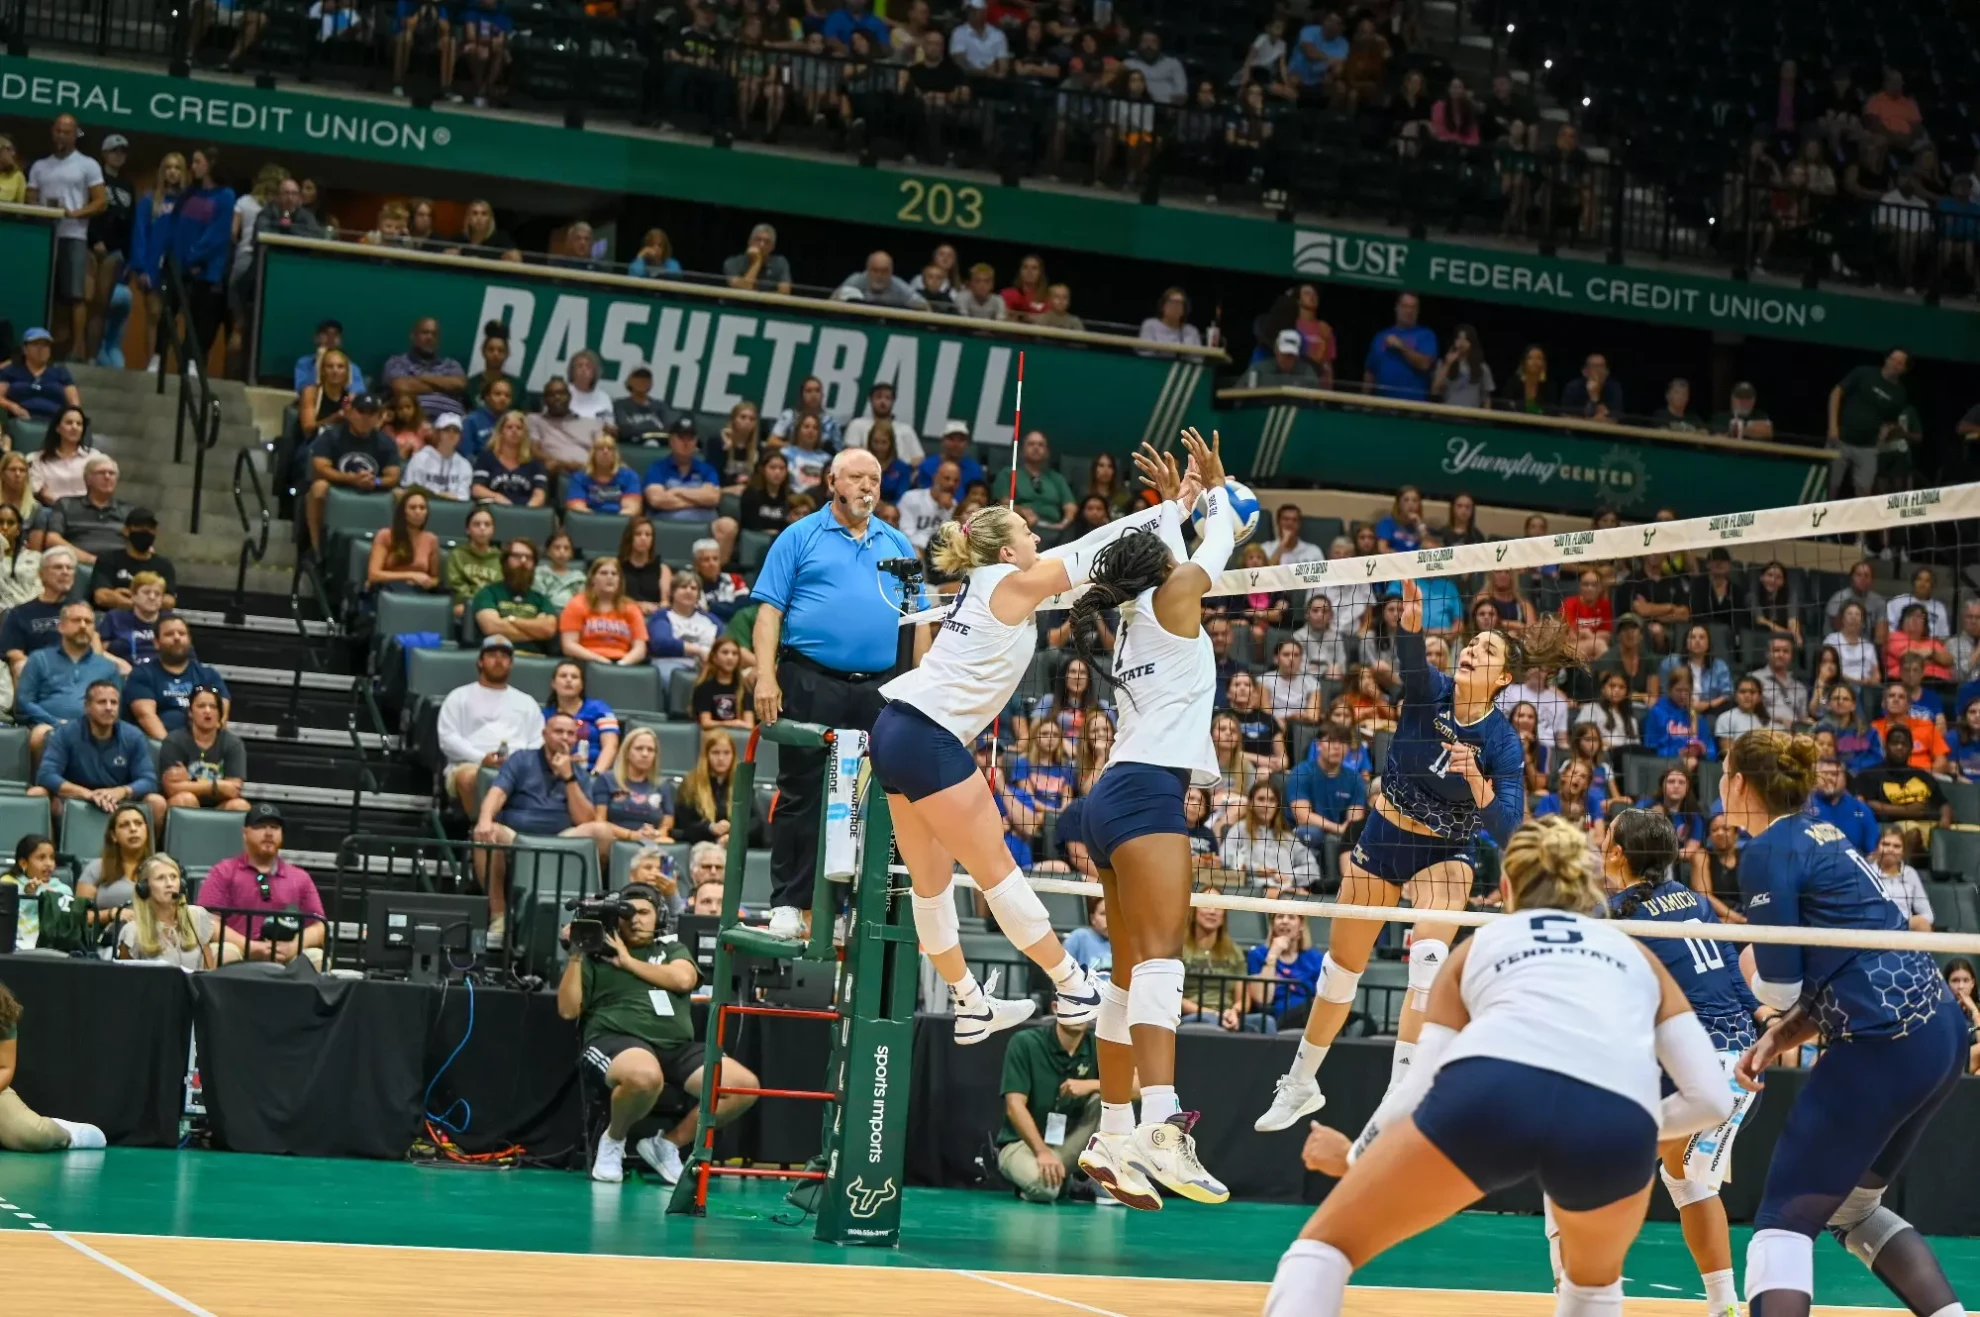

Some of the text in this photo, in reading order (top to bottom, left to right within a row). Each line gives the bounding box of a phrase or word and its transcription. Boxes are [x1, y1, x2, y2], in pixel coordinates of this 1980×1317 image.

[2, 73, 132, 114] DERAL
[150, 92, 292, 132] CREDIT
[897, 179, 983, 229] 203
[1333, 236, 1409, 277] USF
[1429, 257, 1573, 298] FEDERAL
[1585, 277, 1701, 313] CREDIT
[469, 285, 1016, 446] BASKETBALL
[1441, 436, 1634, 486] Yuengling CENTER
[1911, 489, 1941, 507] FLORIDA
[1729, 512, 1755, 528] FLORIDA
[1554, 531, 1594, 547] SOUTH FLORIDA
[1417, 551, 1432, 564] SOUTH
[1118, 662, 1155, 683] TATE
[1644, 890, 1697, 917] D'AMICO
[1749, 891, 1771, 907] ACC
[1530, 914, 1584, 944] 5
[1495, 947, 1628, 974] PENN STATE
[1683, 917, 1725, 975] 10
[868, 1044, 889, 1164] sports imports
[1683, 1129, 1703, 1166] POWERA
[1710, 1125, 1733, 1172] POWERADE
